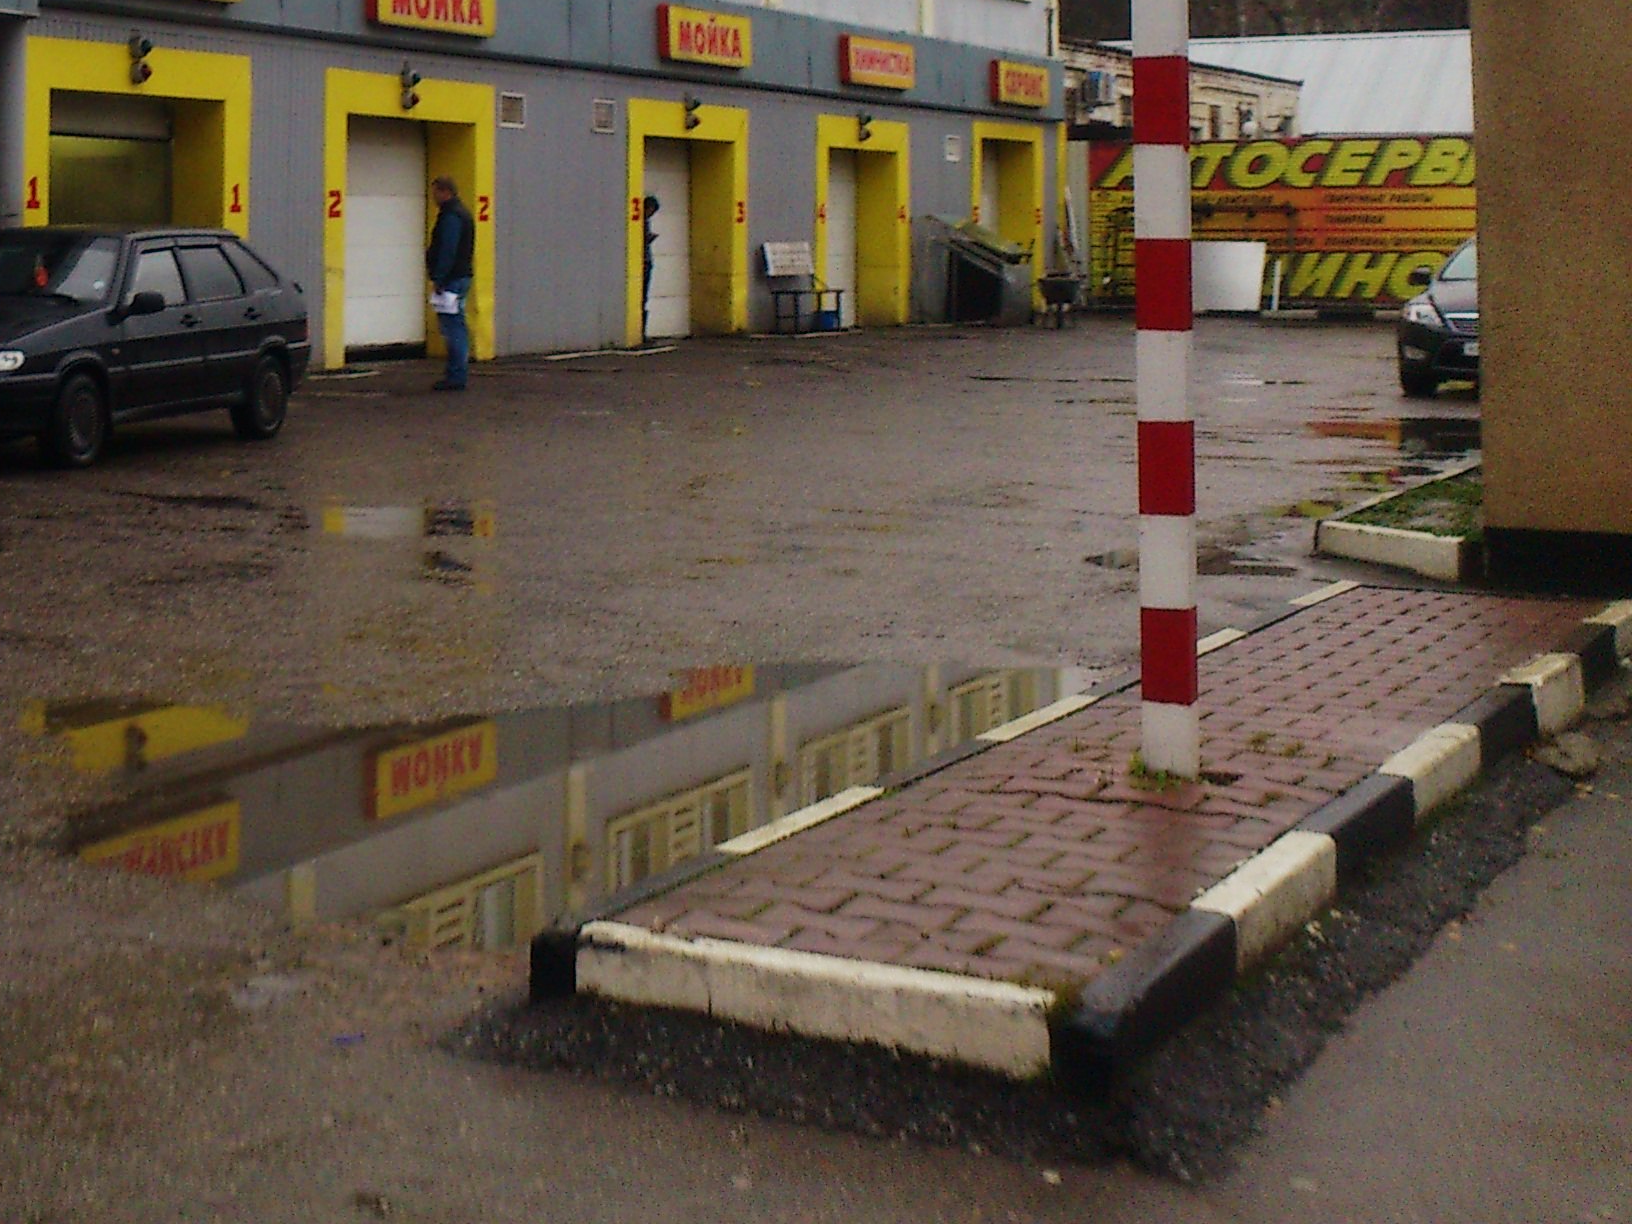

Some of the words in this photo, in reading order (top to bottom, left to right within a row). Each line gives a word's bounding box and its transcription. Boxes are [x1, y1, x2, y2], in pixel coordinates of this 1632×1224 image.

[679, 16, 742, 58] МОЙКА
[27, 177, 40, 209] 1
[230, 184, 242, 213] 1
[327, 190, 342, 218] 2
[478, 196, 489, 221] 2
